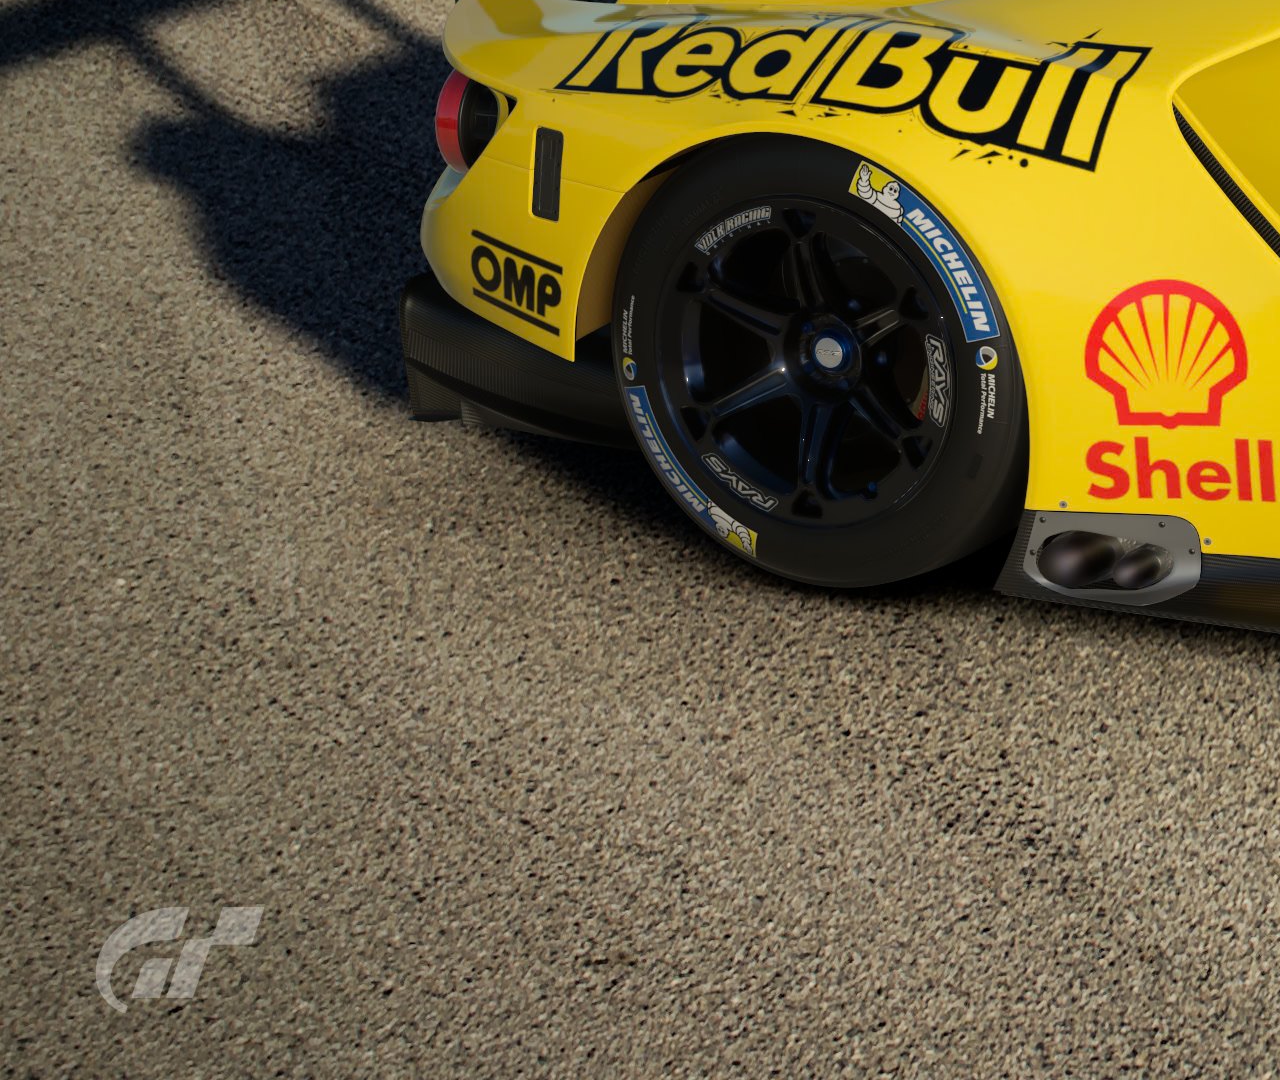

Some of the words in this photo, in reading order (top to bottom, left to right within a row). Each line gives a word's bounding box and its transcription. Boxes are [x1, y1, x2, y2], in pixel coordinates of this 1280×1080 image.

[471, 245, 562, 317] OMP
[906, 208, 990, 332] MICHELIN
[929, 338, 947, 423] RAYS
[977, 391, 986, 435] Performance
[987, 373, 995, 419] MICHELIN
[630, 393, 707, 513] MICHELIN
[703, 456, 775, 509] RAYS
[1085, 436, 1276, 503] Shell
